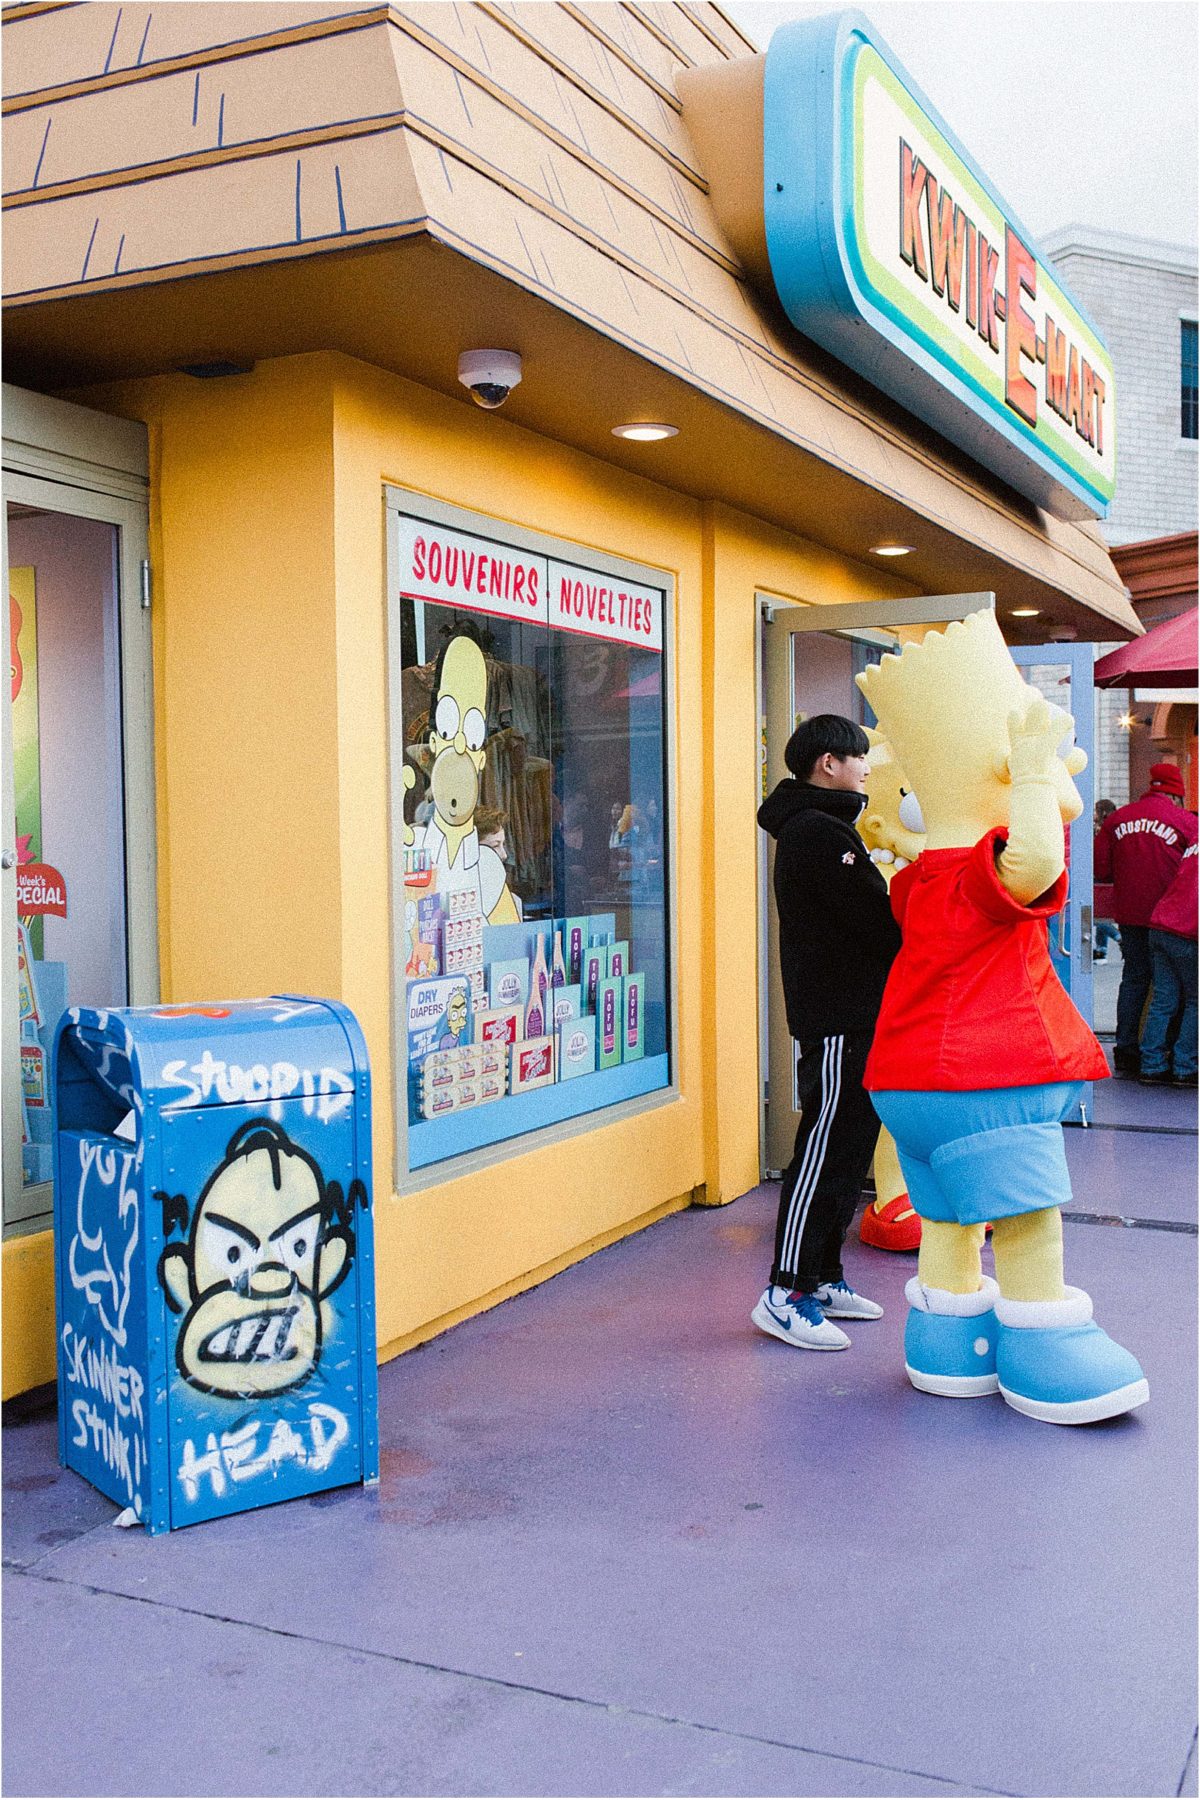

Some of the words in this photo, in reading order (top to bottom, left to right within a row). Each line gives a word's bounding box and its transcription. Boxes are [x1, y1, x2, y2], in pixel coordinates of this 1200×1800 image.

[899, 135, 1107, 457] KWIK-E-MART
[412, 535, 539, 607] SOUVENIRS
[560, 577, 652, 635] NOVELTIES
[1114, 818, 1178, 845] KRUSTYLAND
[19, 875, 46, 887] Week's
[16, 886, 65, 905] PECIAL
[418, 988, 438, 1005] DRY
[410, 1003, 444, 1019] DIAPERS
[63, 1322, 145, 1430] SKINNER
[177, 1402, 350, 1502] HEAD
